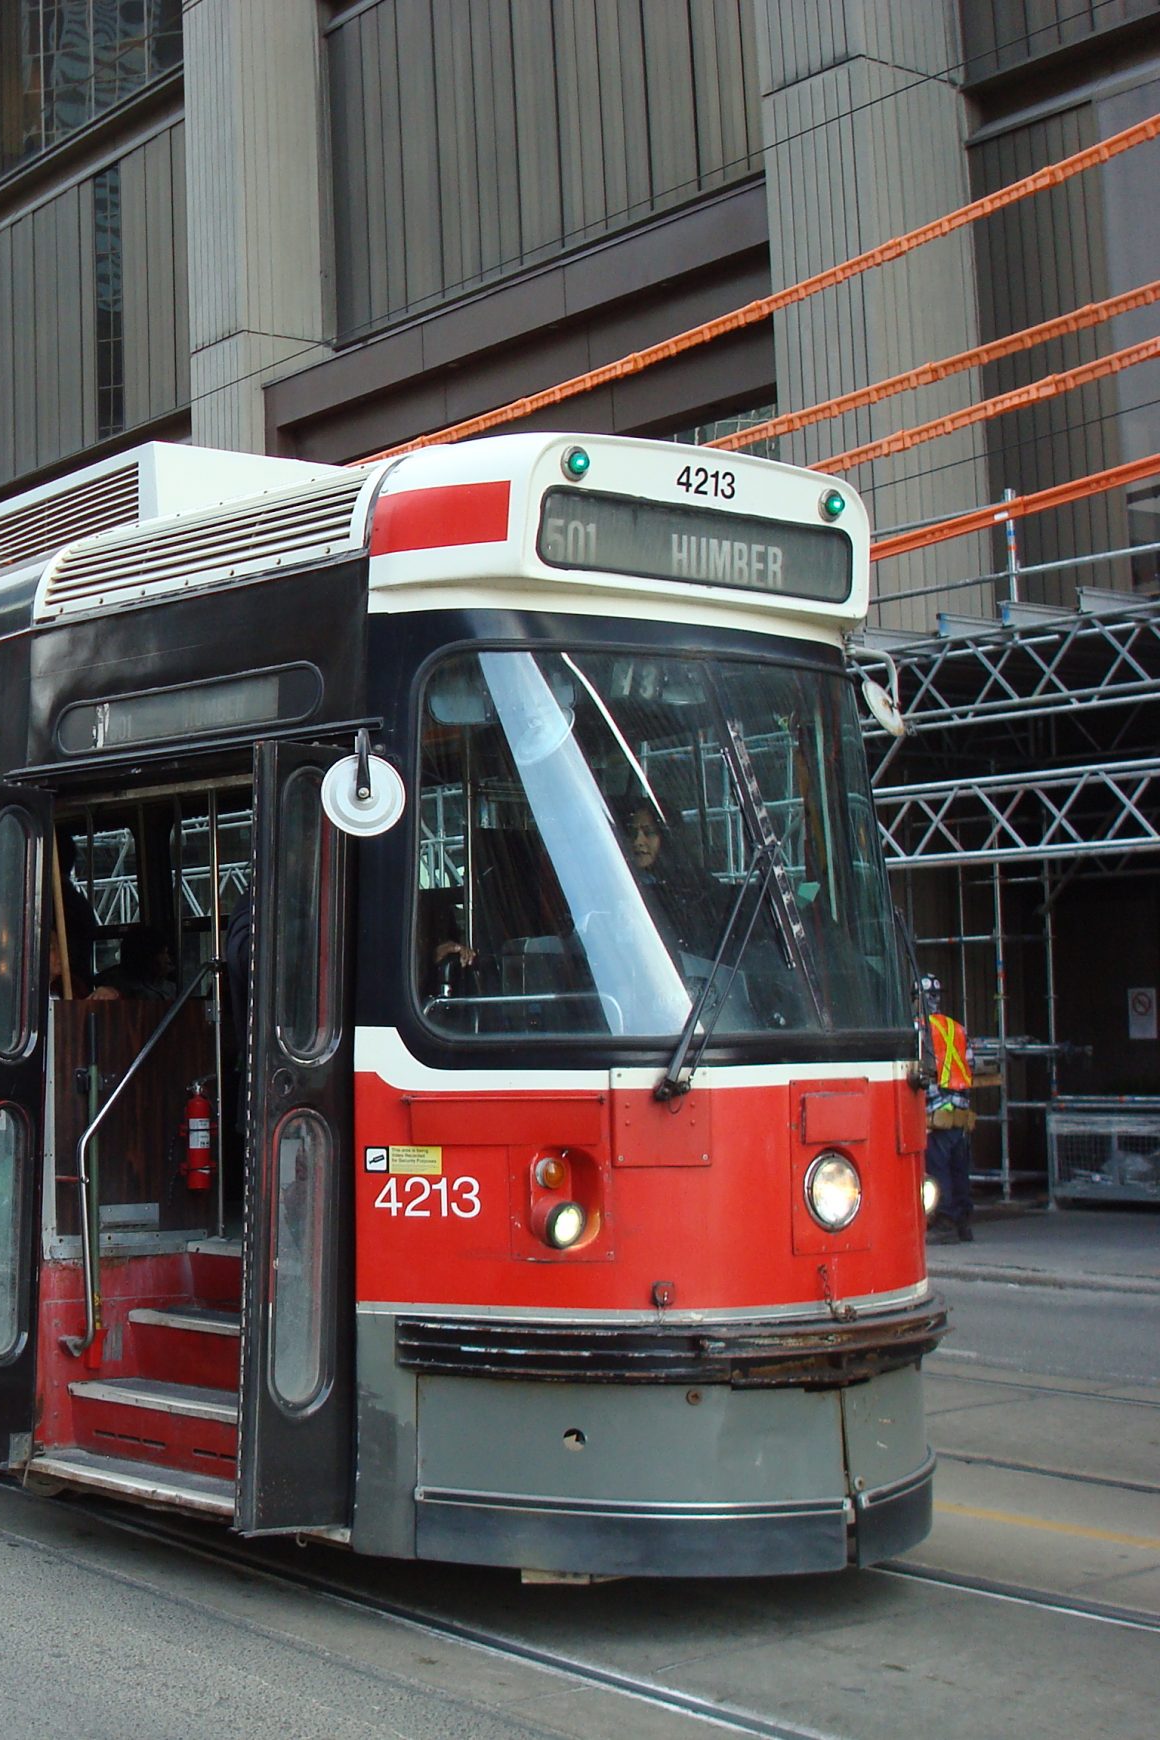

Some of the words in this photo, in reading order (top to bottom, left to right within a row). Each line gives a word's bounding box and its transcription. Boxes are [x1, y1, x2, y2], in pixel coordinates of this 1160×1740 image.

[676, 465, 736, 500] 4213
[546, 517, 597, 564] 501
[672, 533, 783, 589] HUMBER
[374, 1176, 481, 1219] 4213
